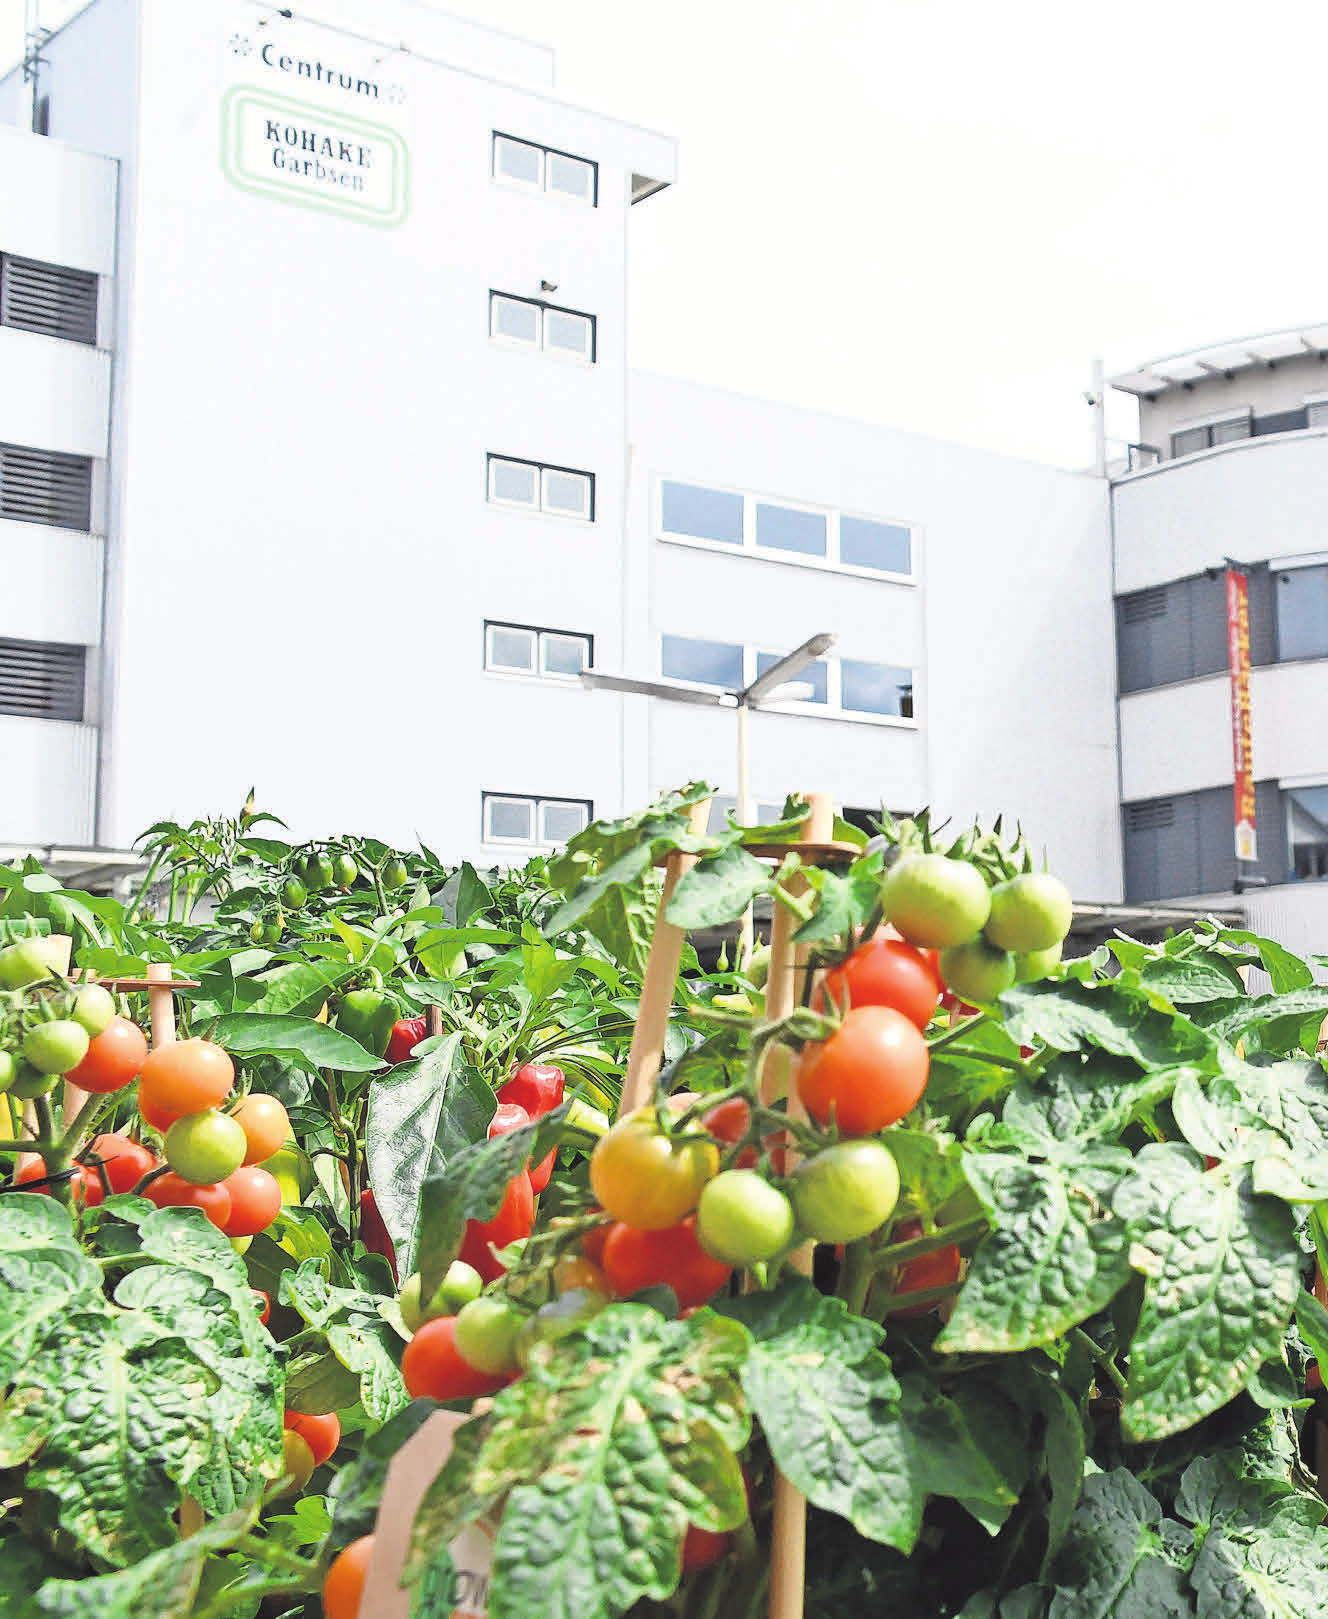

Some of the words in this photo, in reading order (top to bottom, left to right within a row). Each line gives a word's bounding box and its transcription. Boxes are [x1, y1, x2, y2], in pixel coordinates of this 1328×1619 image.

[261, 43, 379, 98] Centrum
[265, 120, 372, 169] KOHAKE
[272, 147, 365, 192] Garbsen
